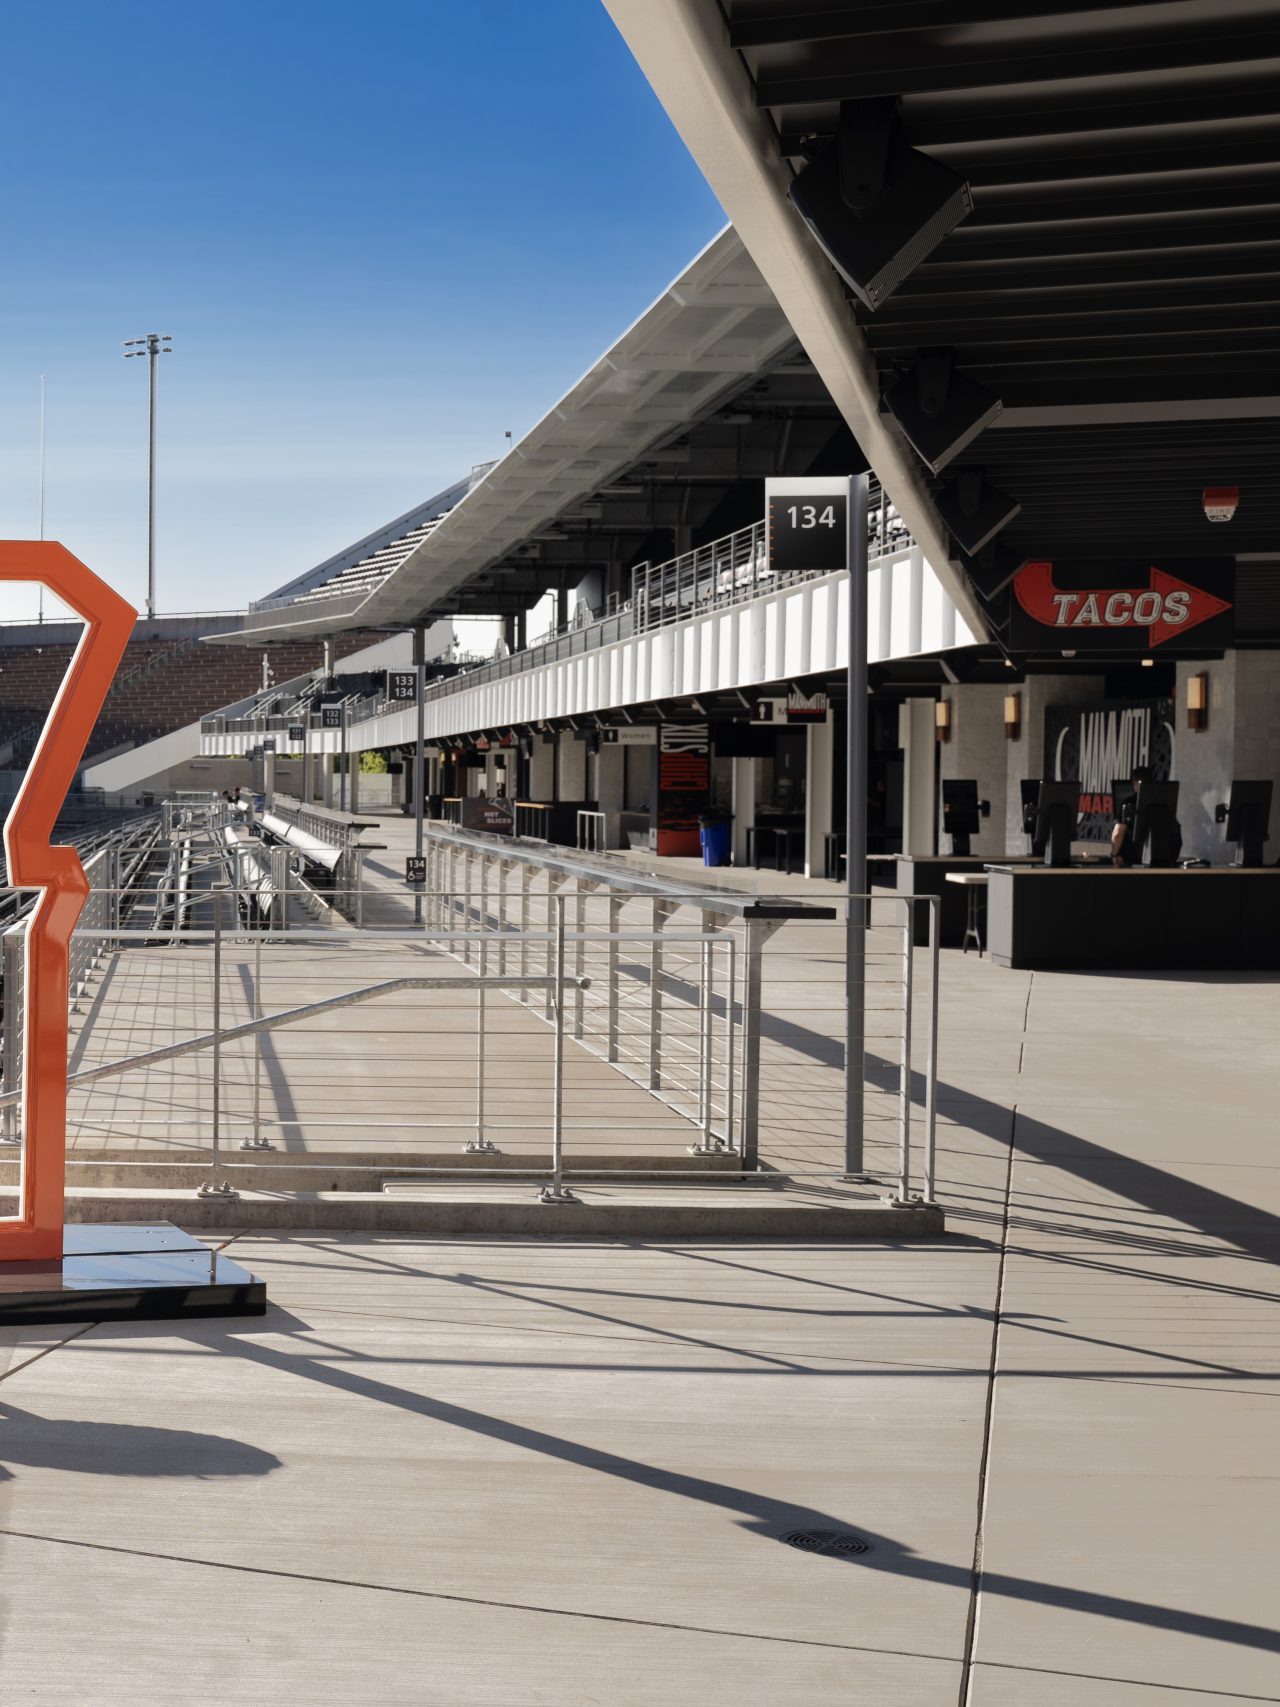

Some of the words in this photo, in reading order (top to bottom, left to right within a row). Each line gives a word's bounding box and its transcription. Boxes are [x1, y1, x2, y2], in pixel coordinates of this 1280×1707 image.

[787, 505, 836, 528] 134
[1052, 591, 1192, 627] TACOS
[395, 676, 414, 686] 133
[394, 687, 414, 697] 134
[1079, 794, 1113, 813] MAR
[409, 859, 425, 868] 134
